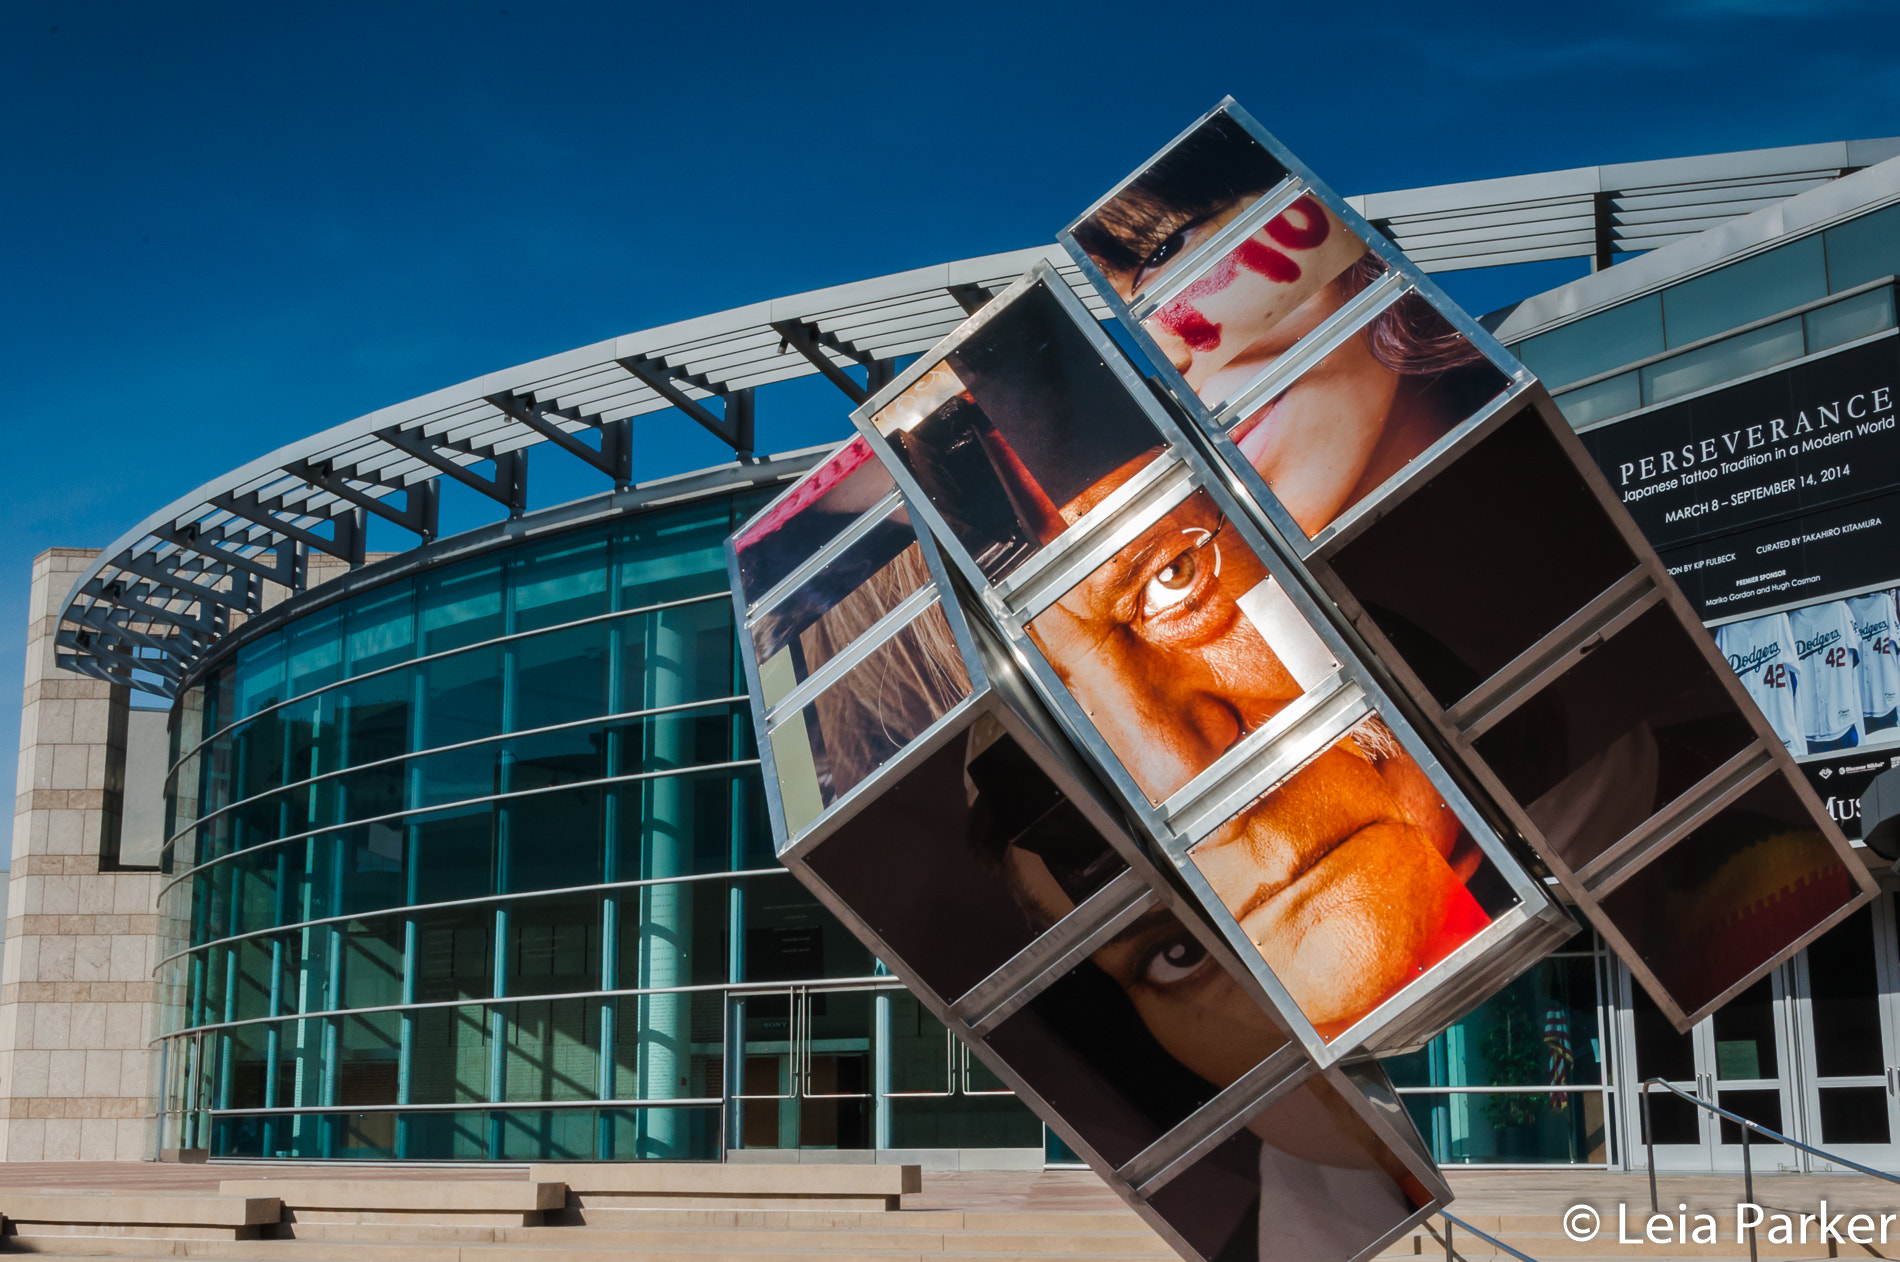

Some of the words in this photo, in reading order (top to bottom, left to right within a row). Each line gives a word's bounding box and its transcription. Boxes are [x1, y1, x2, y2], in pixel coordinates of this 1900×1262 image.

[1620, 387, 1893, 485] PERSEVERANCE
[1622, 478, 1678, 503] Japanese
[1681, 466, 1718, 488] Tattoo
[1721, 450, 1772, 475] Tradition
[1775, 447, 1786, 460] in
[1789, 445, 1799, 456] a
[1802, 428, 1853, 452] Modern
[1856, 415, 1895, 436] World
[1665, 502, 1709, 523] MARCH
[1711, 500, 1719, 512] 8
[1730, 478, 1796, 506] SEPTEMBER
[1800, 474, 1817, 488] 14,
[1820, 464, 1851, 483] 2014
[1756, 538, 1791, 555] CURATED
[1792, 536, 1802, 546] BY
[1802, 526, 1842, 544] TAKAHIRO
[1842, 518, 1882, 533] KITAMURA
[1684, 564, 1693, 572] BY
[1694, 560, 1705, 570] KIP
[1706, 552, 1736, 567] FULBECK
[1706, 596, 1728, 607] Mariko
[1728, 590, 1756, 602] Gordon
[1756, 585, 1771, 595] and
[1772, 581, 1791, 592] Hugh
[1791, 575, 1821, 588] Cosman
[1736, 577, 1760, 587] PREMIER
[1760, 569, 1787, 582] SPONSOR
[1728, 642, 1781, 677] Dodgers
[1795, 629, 1841, 660] Dodgers
[1825, 646, 1846, 668] 42
[1873, 636, 1891, 654] 42
[1763, 664, 1786, 688] 42
